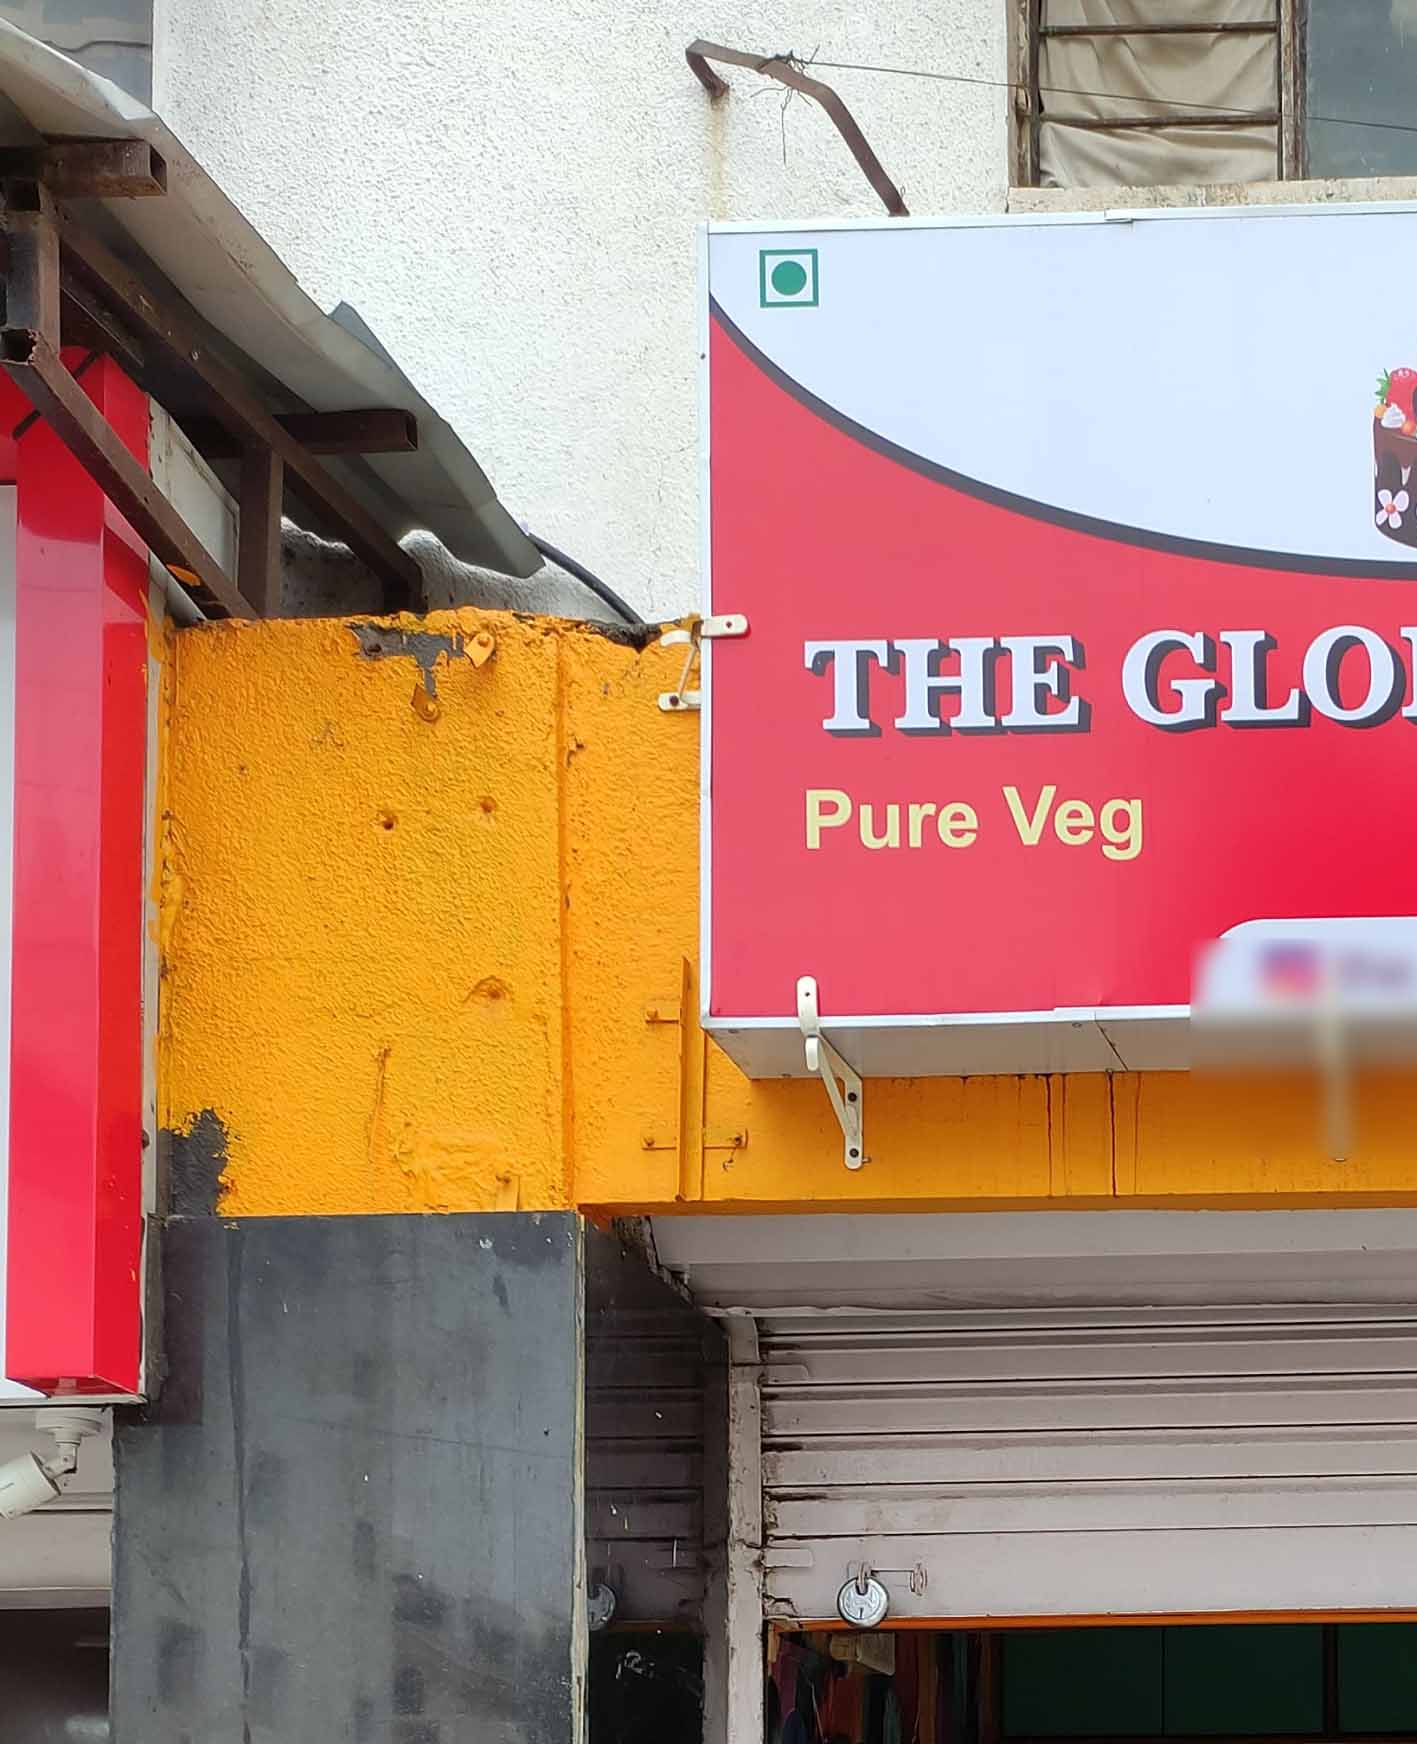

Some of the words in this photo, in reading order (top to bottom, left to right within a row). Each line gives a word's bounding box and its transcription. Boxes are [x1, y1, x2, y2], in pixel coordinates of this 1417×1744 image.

[804, 634, 1091, 738] THE
[805, 788, 979, 850] Pure
[1002, 785, 1144, 861] Veg
